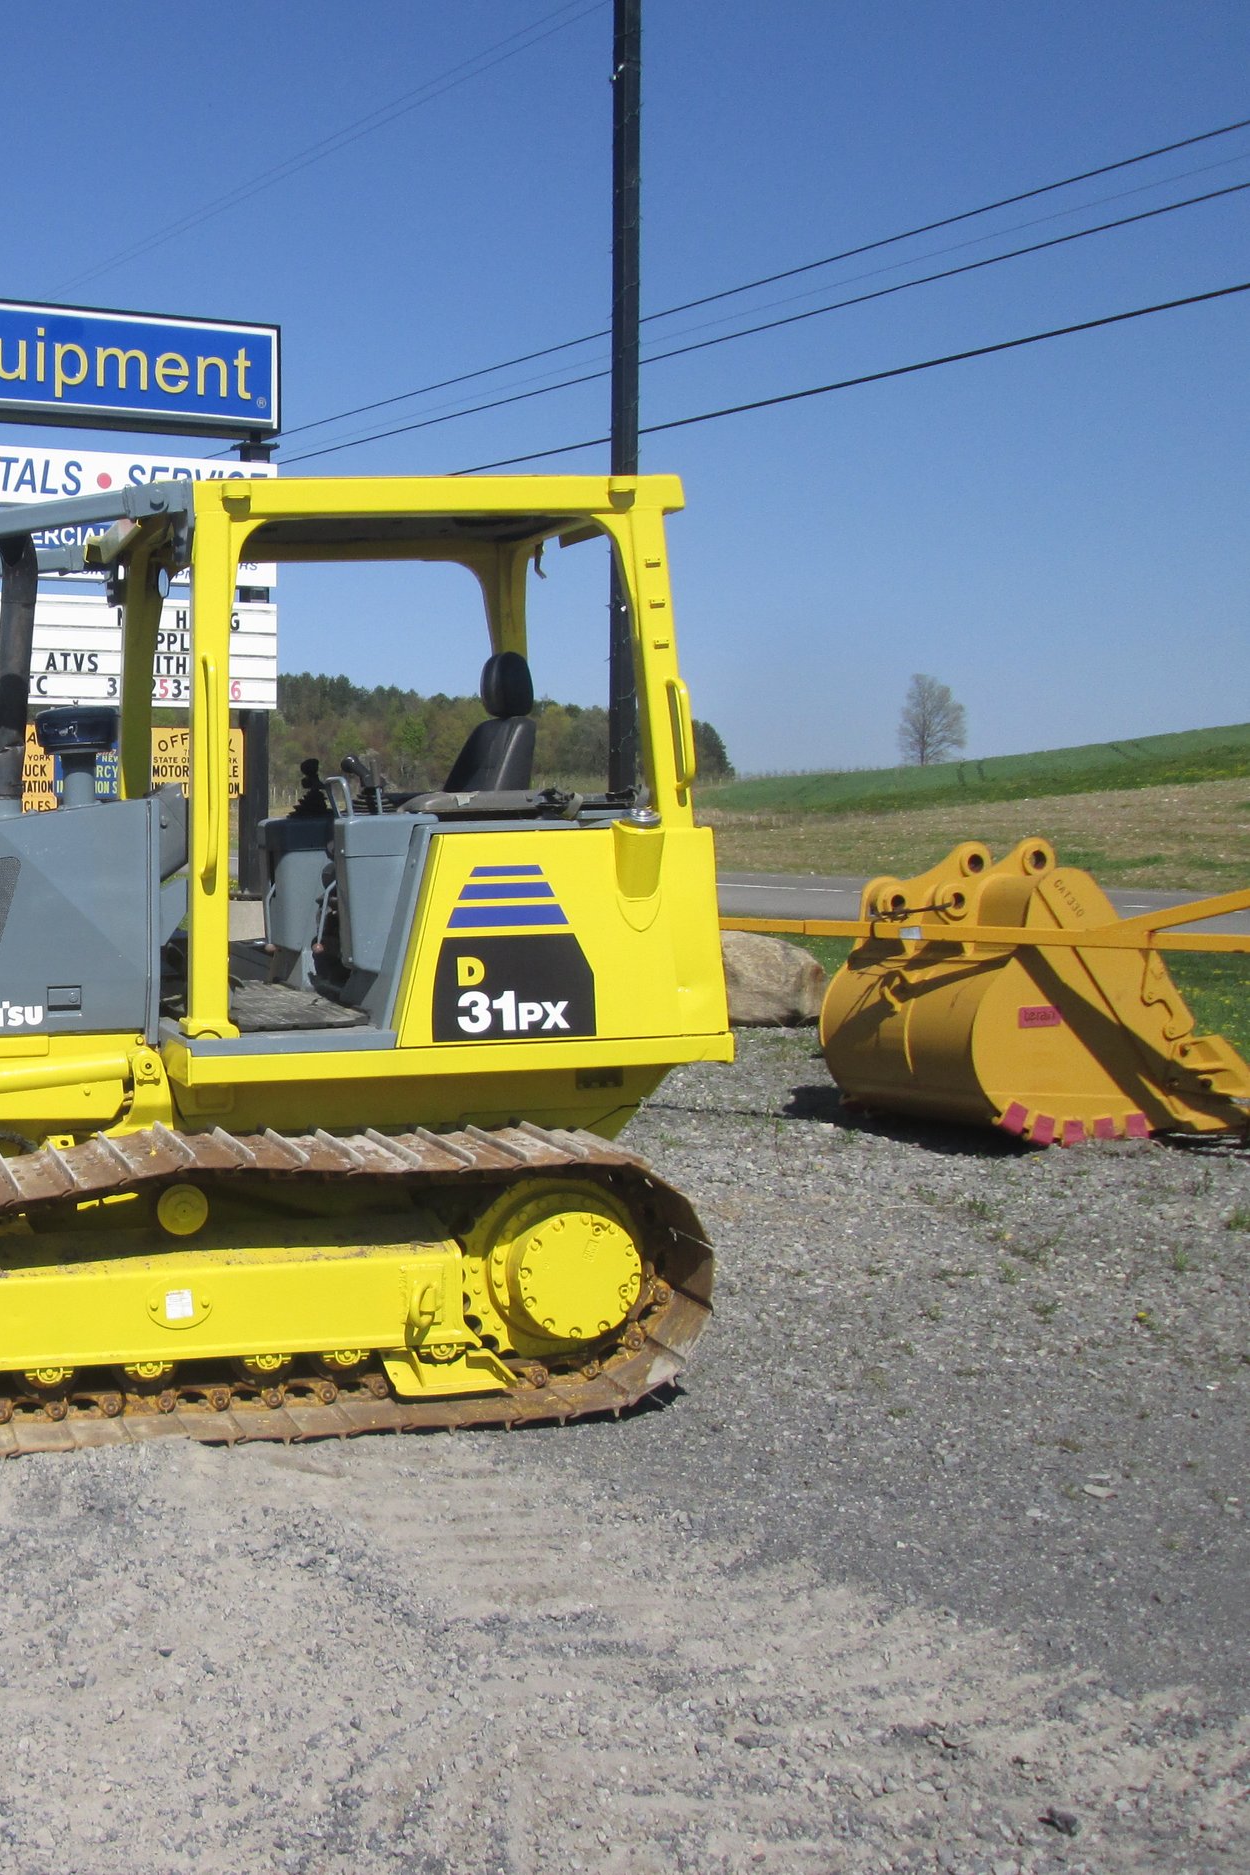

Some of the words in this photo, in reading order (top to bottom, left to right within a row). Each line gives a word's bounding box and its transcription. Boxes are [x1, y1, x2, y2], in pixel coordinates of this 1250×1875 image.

[45, 652, 99, 673] ATVS
[27, 754, 51, 762] YORK
[153, 756, 178, 764] STATE
[24, 764, 47, 777] UCK
[152, 764, 190, 778] MOTOR
[457, 956, 486, 987] D
[457, 990, 571, 1033] 31PX
